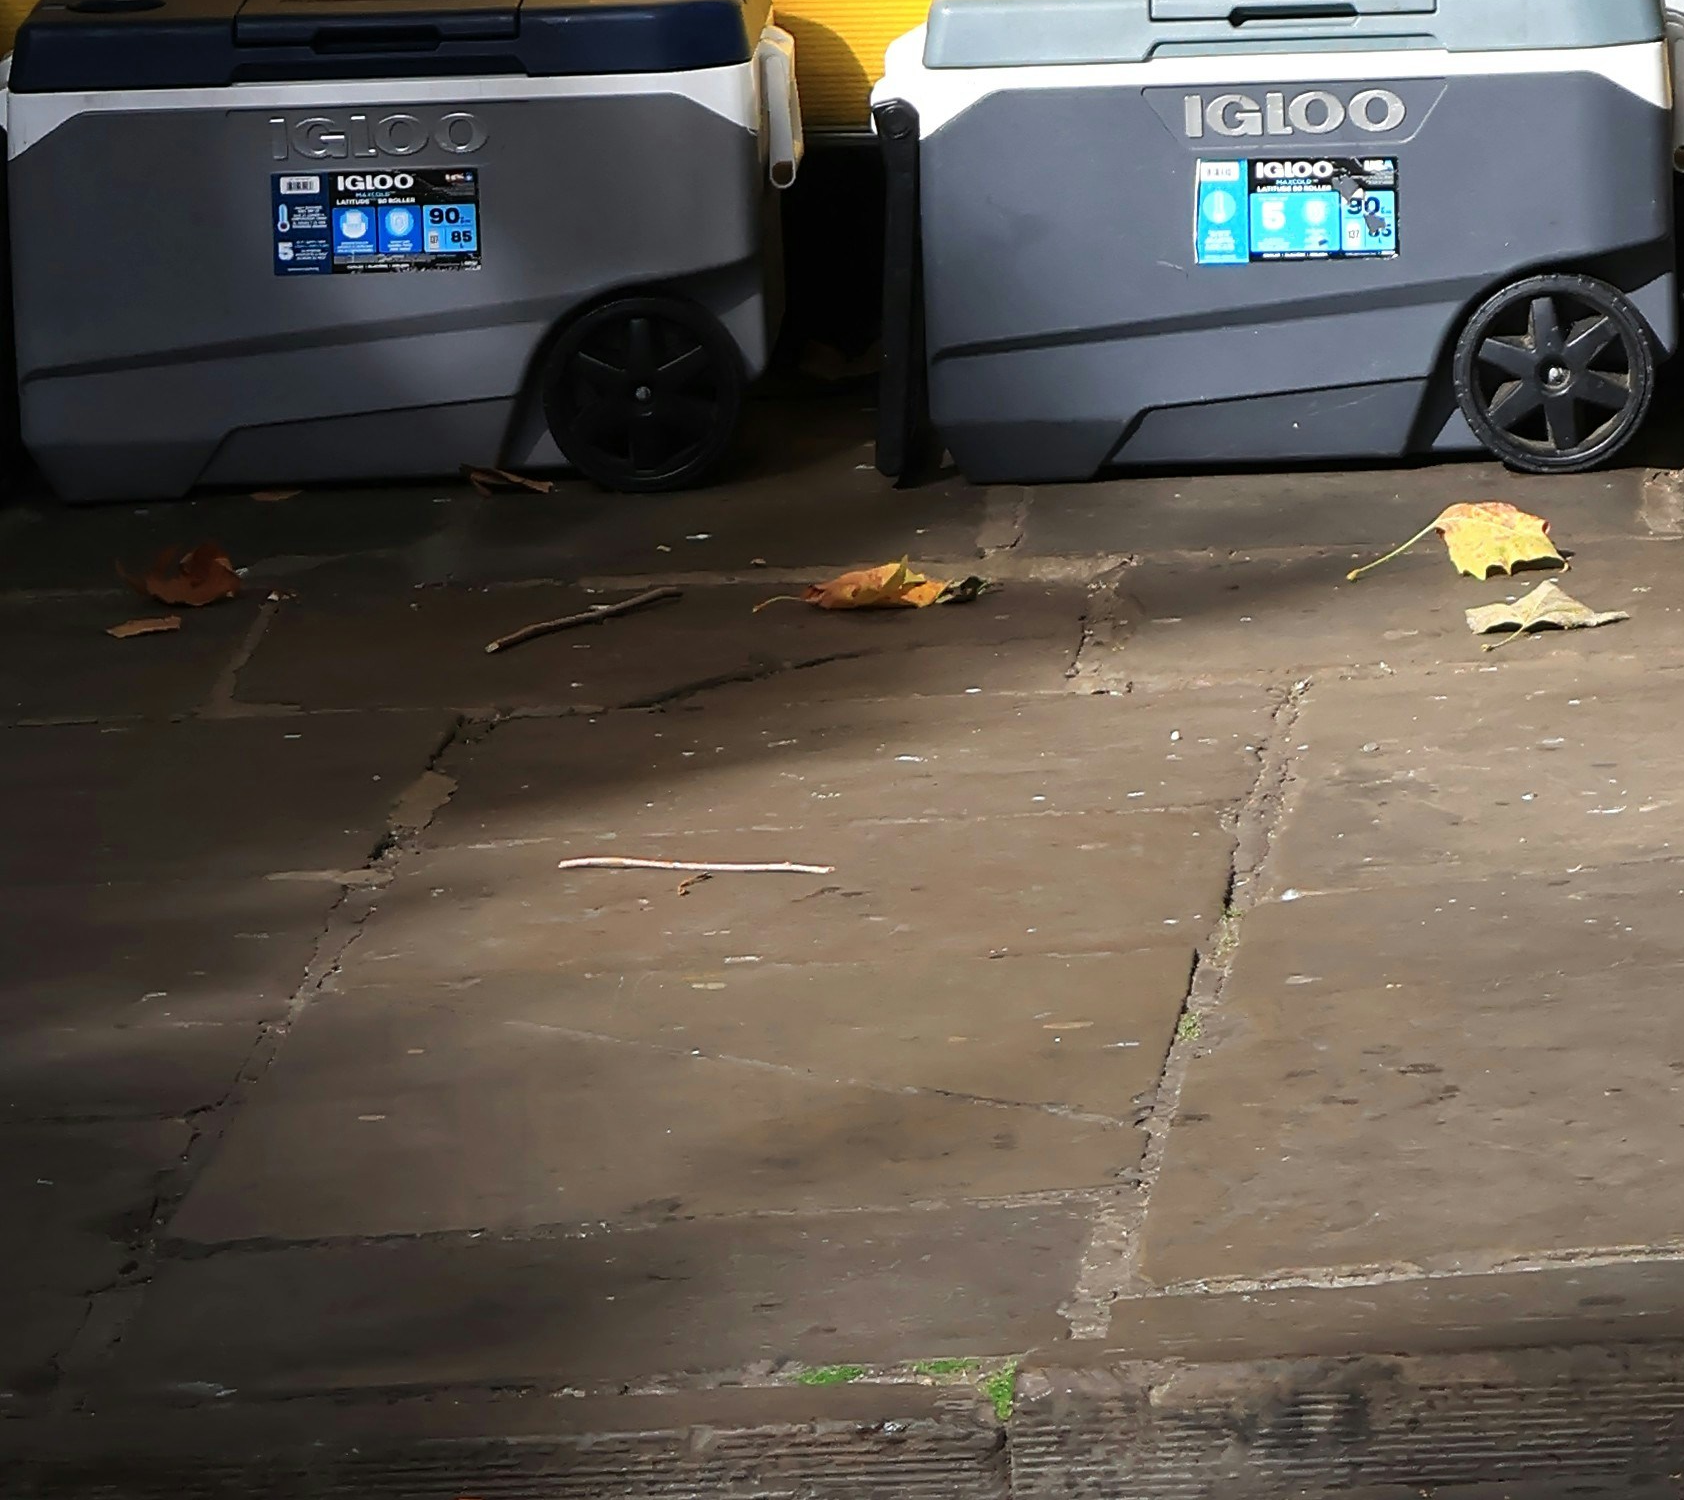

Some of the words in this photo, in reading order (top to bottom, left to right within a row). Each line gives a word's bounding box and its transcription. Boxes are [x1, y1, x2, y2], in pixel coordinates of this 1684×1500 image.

[1184, 89, 1406, 137] IGLOO
[269, 112, 489, 160] IGLOO
[1256, 161, 1334, 178] IGLOO
[337, 173, 414, 191] IGLOO
[1347, 196, 1380, 214] 90
[429, 207, 460, 224] 90
[1261, 201, 1286, 230] 5
[451, 230, 472, 242] 85
[278, 242, 294, 260] 5
